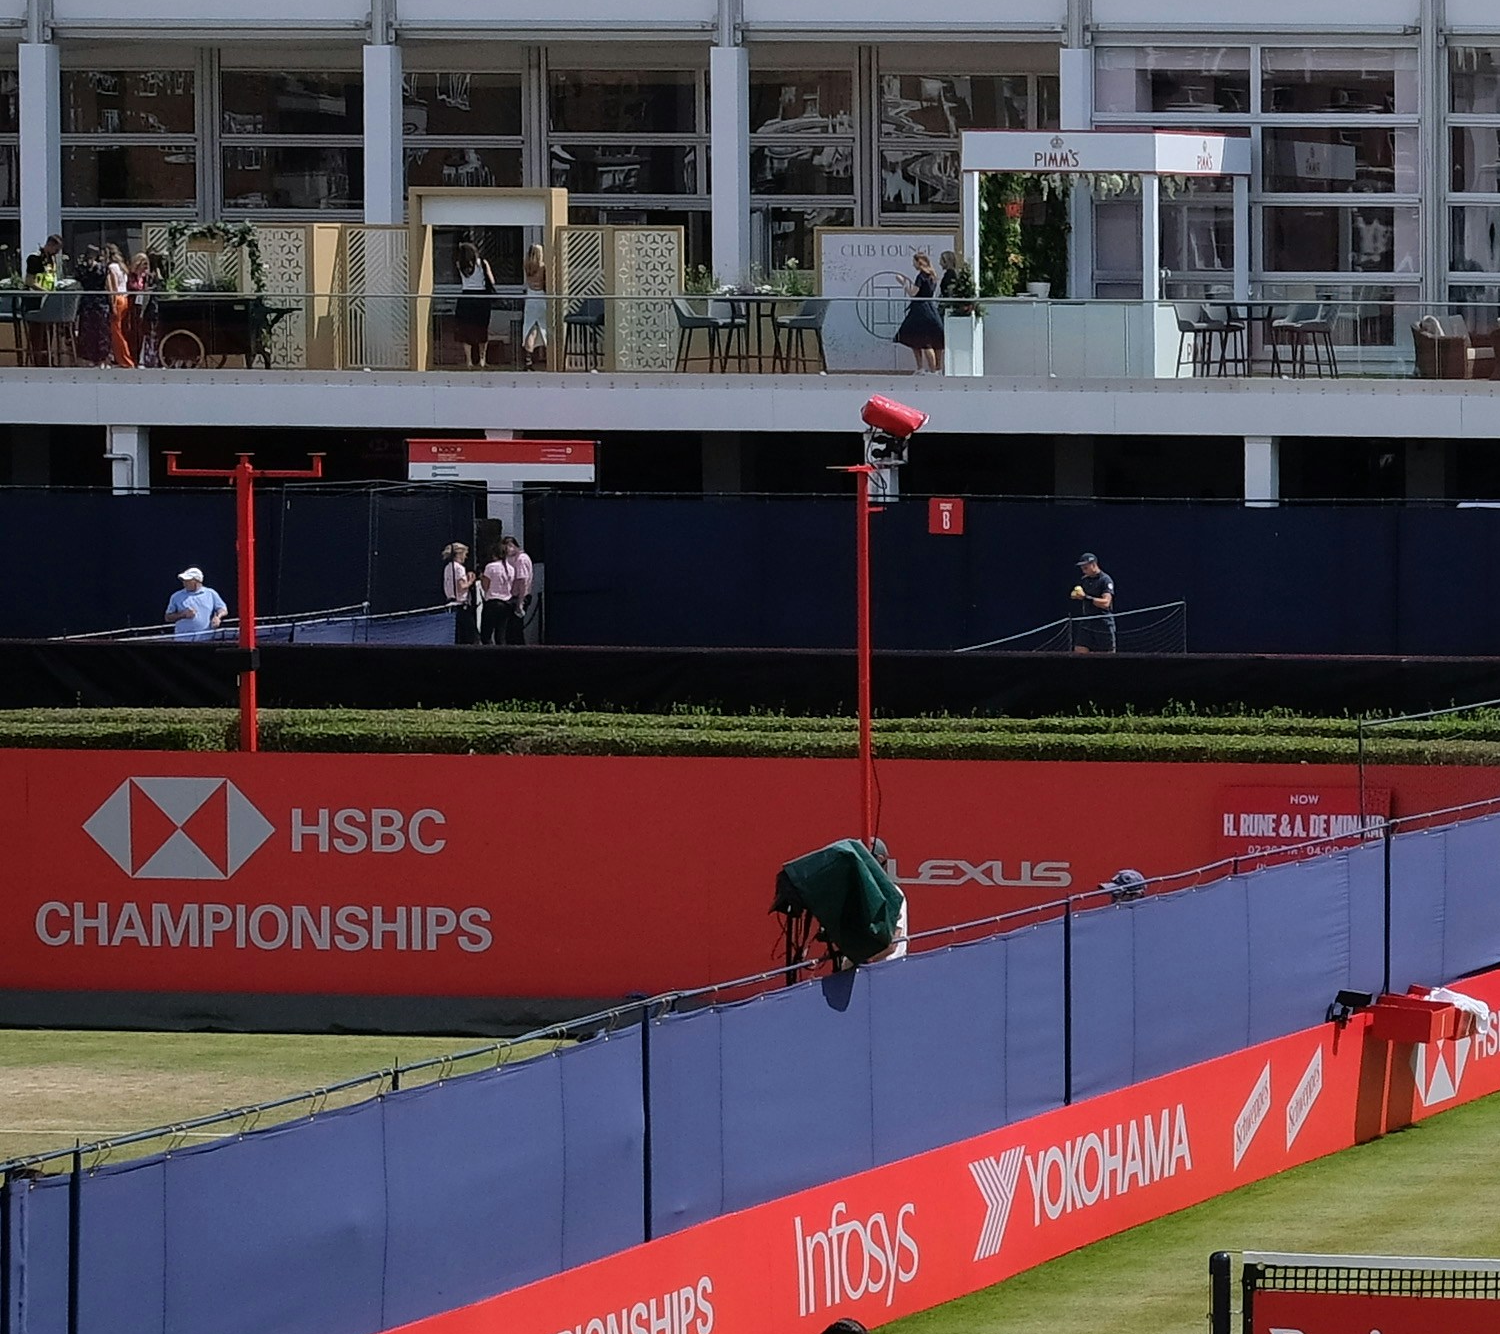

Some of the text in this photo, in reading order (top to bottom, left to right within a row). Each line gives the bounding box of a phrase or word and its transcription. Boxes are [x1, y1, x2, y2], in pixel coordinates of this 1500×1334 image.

[1035, 149, 1080, 168] PIMM'S
[841, 244, 875, 257] CLUB
[1290, 795, 1319, 805] NOW
[290, 808, 446, 854] HSBC
[1240, 814, 1277, 837] RUNE
[1279, 814, 1292, 838] &
[1309, 815, 1328, 838] DE
[887, 858, 1073, 888] LEXUS
[35, 901, 493, 952] CHAMPIONSHIPS
[1025, 1103, 1191, 1228] YOKOHAMA
[794, 1200, 919, 1317] Infosys
